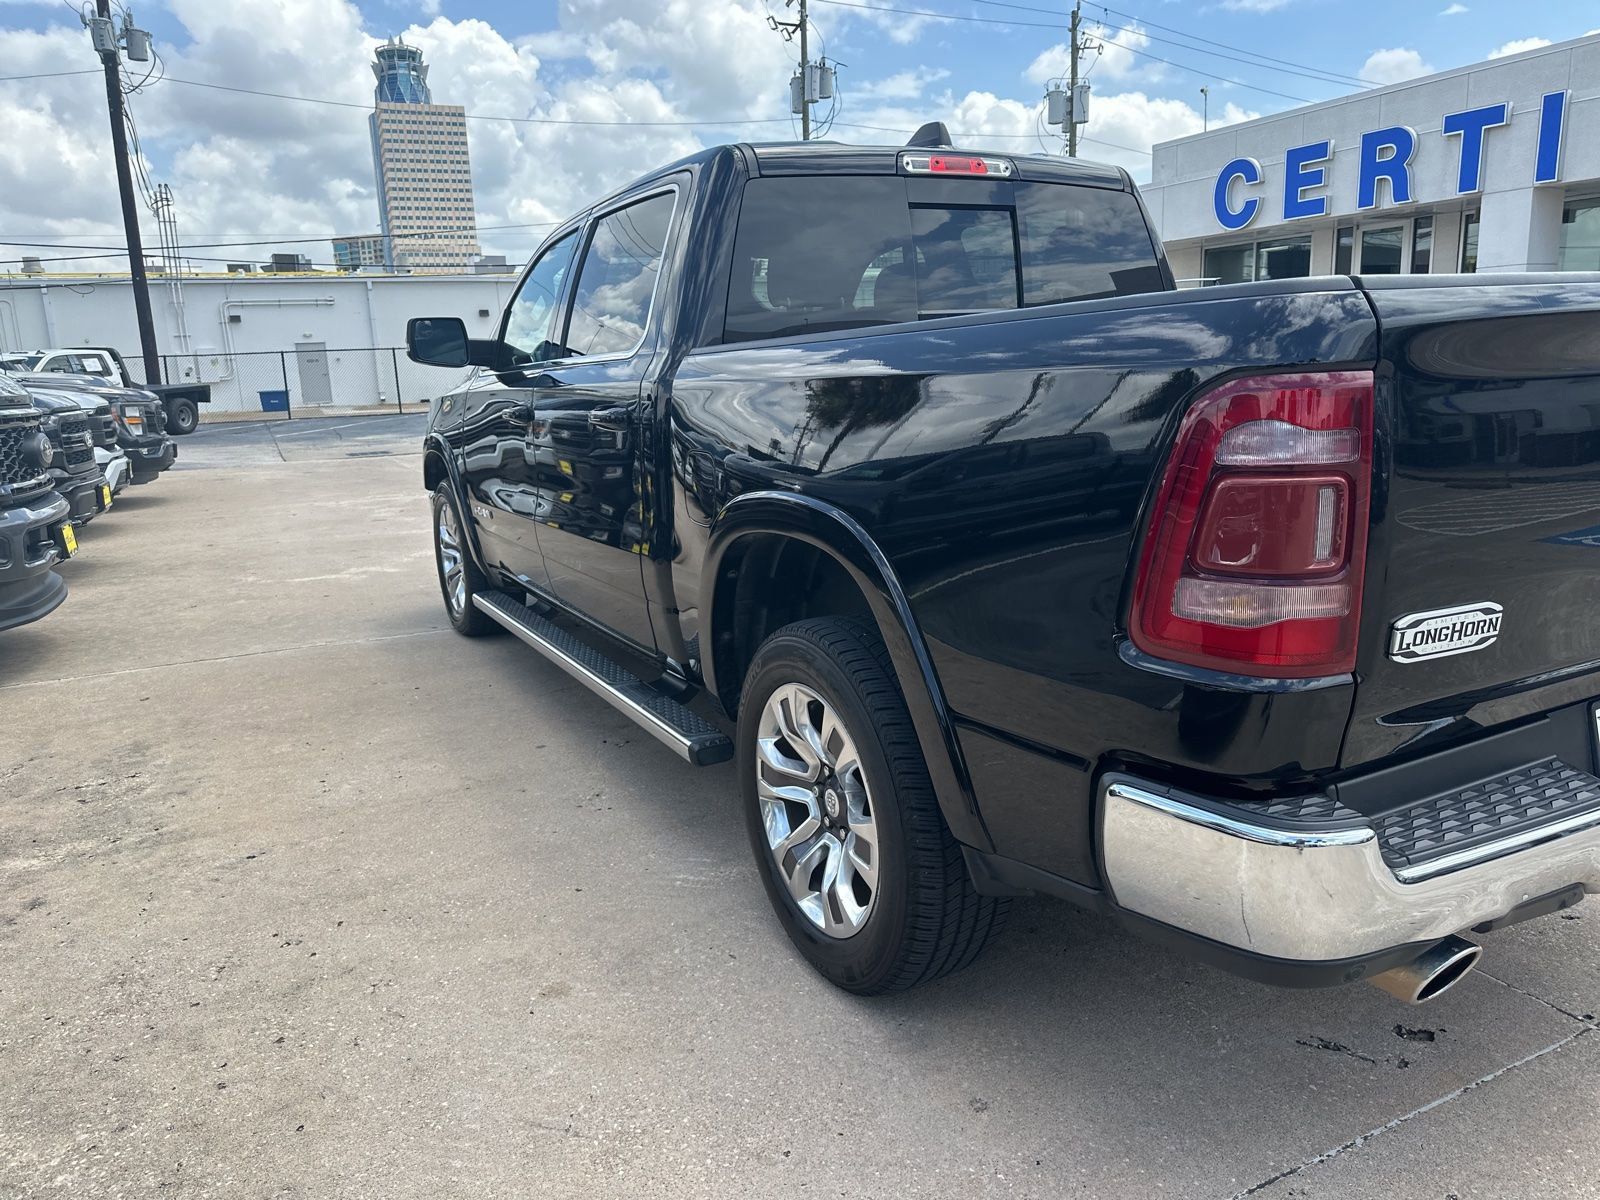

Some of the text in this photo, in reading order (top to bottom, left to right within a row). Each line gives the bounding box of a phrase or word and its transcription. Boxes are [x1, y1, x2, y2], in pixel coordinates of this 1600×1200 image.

[1213, 89, 1571, 231] CERTI
[1426, 612, 1479, 626] LIMITED
[1397, 616, 1500, 652] LONGHORN
[1421, 640, 1474, 653] EDITION
